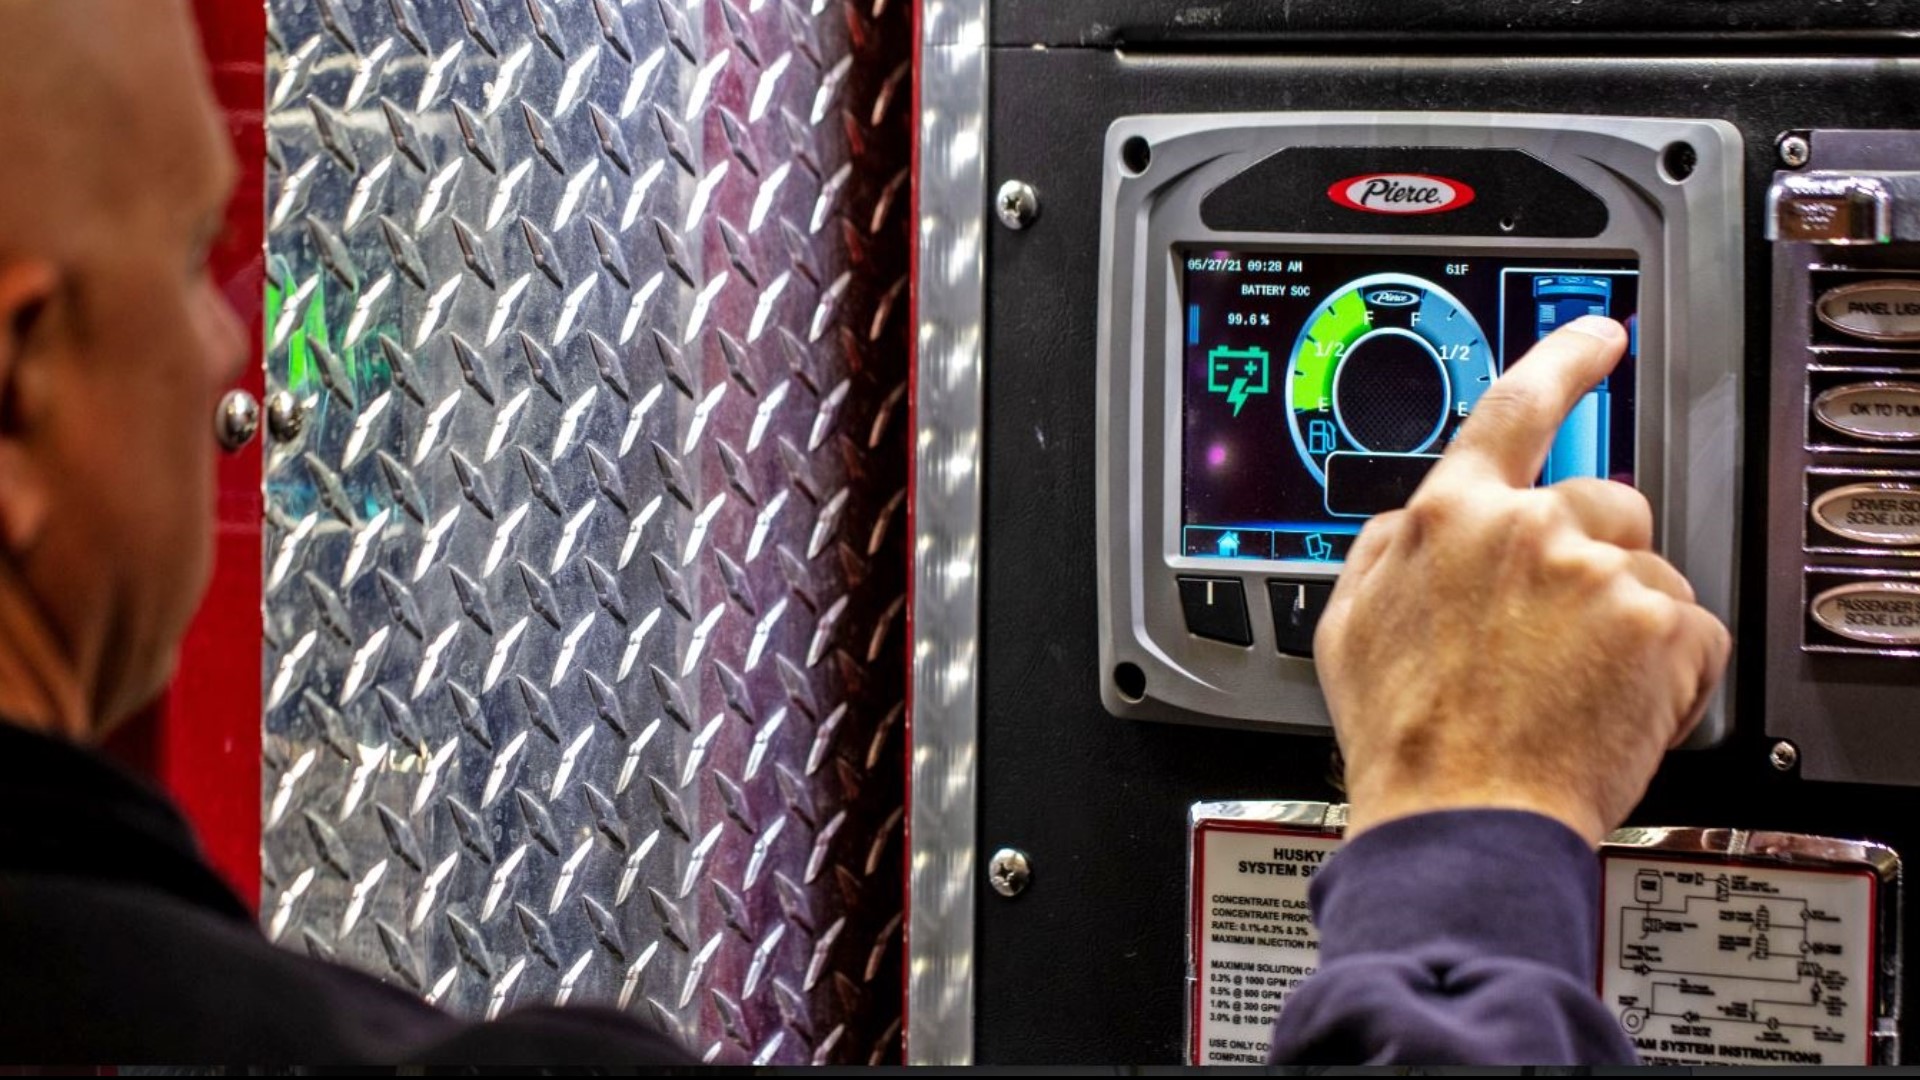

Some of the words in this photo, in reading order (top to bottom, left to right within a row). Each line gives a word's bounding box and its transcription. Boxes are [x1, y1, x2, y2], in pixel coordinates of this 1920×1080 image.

[1187, 259, 1242, 272] 05/27/21
[1247, 260, 1282, 272] 09:28
[1287, 261, 1303, 273] AM
[1446, 264, 1469, 275] 61F
[1241, 284, 1286, 296] BATTERY
[1290, 285, 1311, 297] SOC
[1848, 301, 1892, 316] PANEL
[1363, 311, 1374, 325] F
[1411, 311, 1421, 326] F
[1314, 341, 1344, 358] 1/2
[1440, 344, 1470, 361] 1/2
[1319, 397, 1330, 413] E
[1457, 401, 1468, 416] E
[1850, 402, 1871, 416] OK
[1875, 403, 1892, 417] TO
[1852, 498, 1897, 512] DRIVER
[1847, 511, 1889, 526] SCENE
[1837, 599, 1913, 613] PASSENGER
[1845, 611, 1888, 626] SCENE
[1273, 848, 1325, 863] HUSKY
[1238, 861, 1297, 877] SYSTEM
[1212, 895, 1280, 908] CONCENTRATE
[1212, 908, 1280, 921] CONCENTRATE
[1212, 921, 1238, 931] RATE:
[1211, 934, 1255, 945] MAXIMUM
[1257, 937, 1304, 948] INJECTION
[1211, 960, 1255, 971] MAXIMUM
[1257, 963, 1302, 975] SOLUTION
[1233, 975, 1242, 986] @
[1267, 977, 1287, 987] GPM
[1233, 988, 1242, 999] @
[1261, 990, 1282, 1000] GPM
[1232, 1001, 1242, 1012] @
[1232, 1014, 1242, 1025] @
[1209, 1038, 1228, 1048] USE
[1230, 1040, 1254, 1050] ONLY
[1209, 1052, 1267, 1065] COMPATIBLE
[1660, 1040, 1715, 1056] SYSTEM
[1719, 1044, 1822, 1065] INSTRUCTIONS
